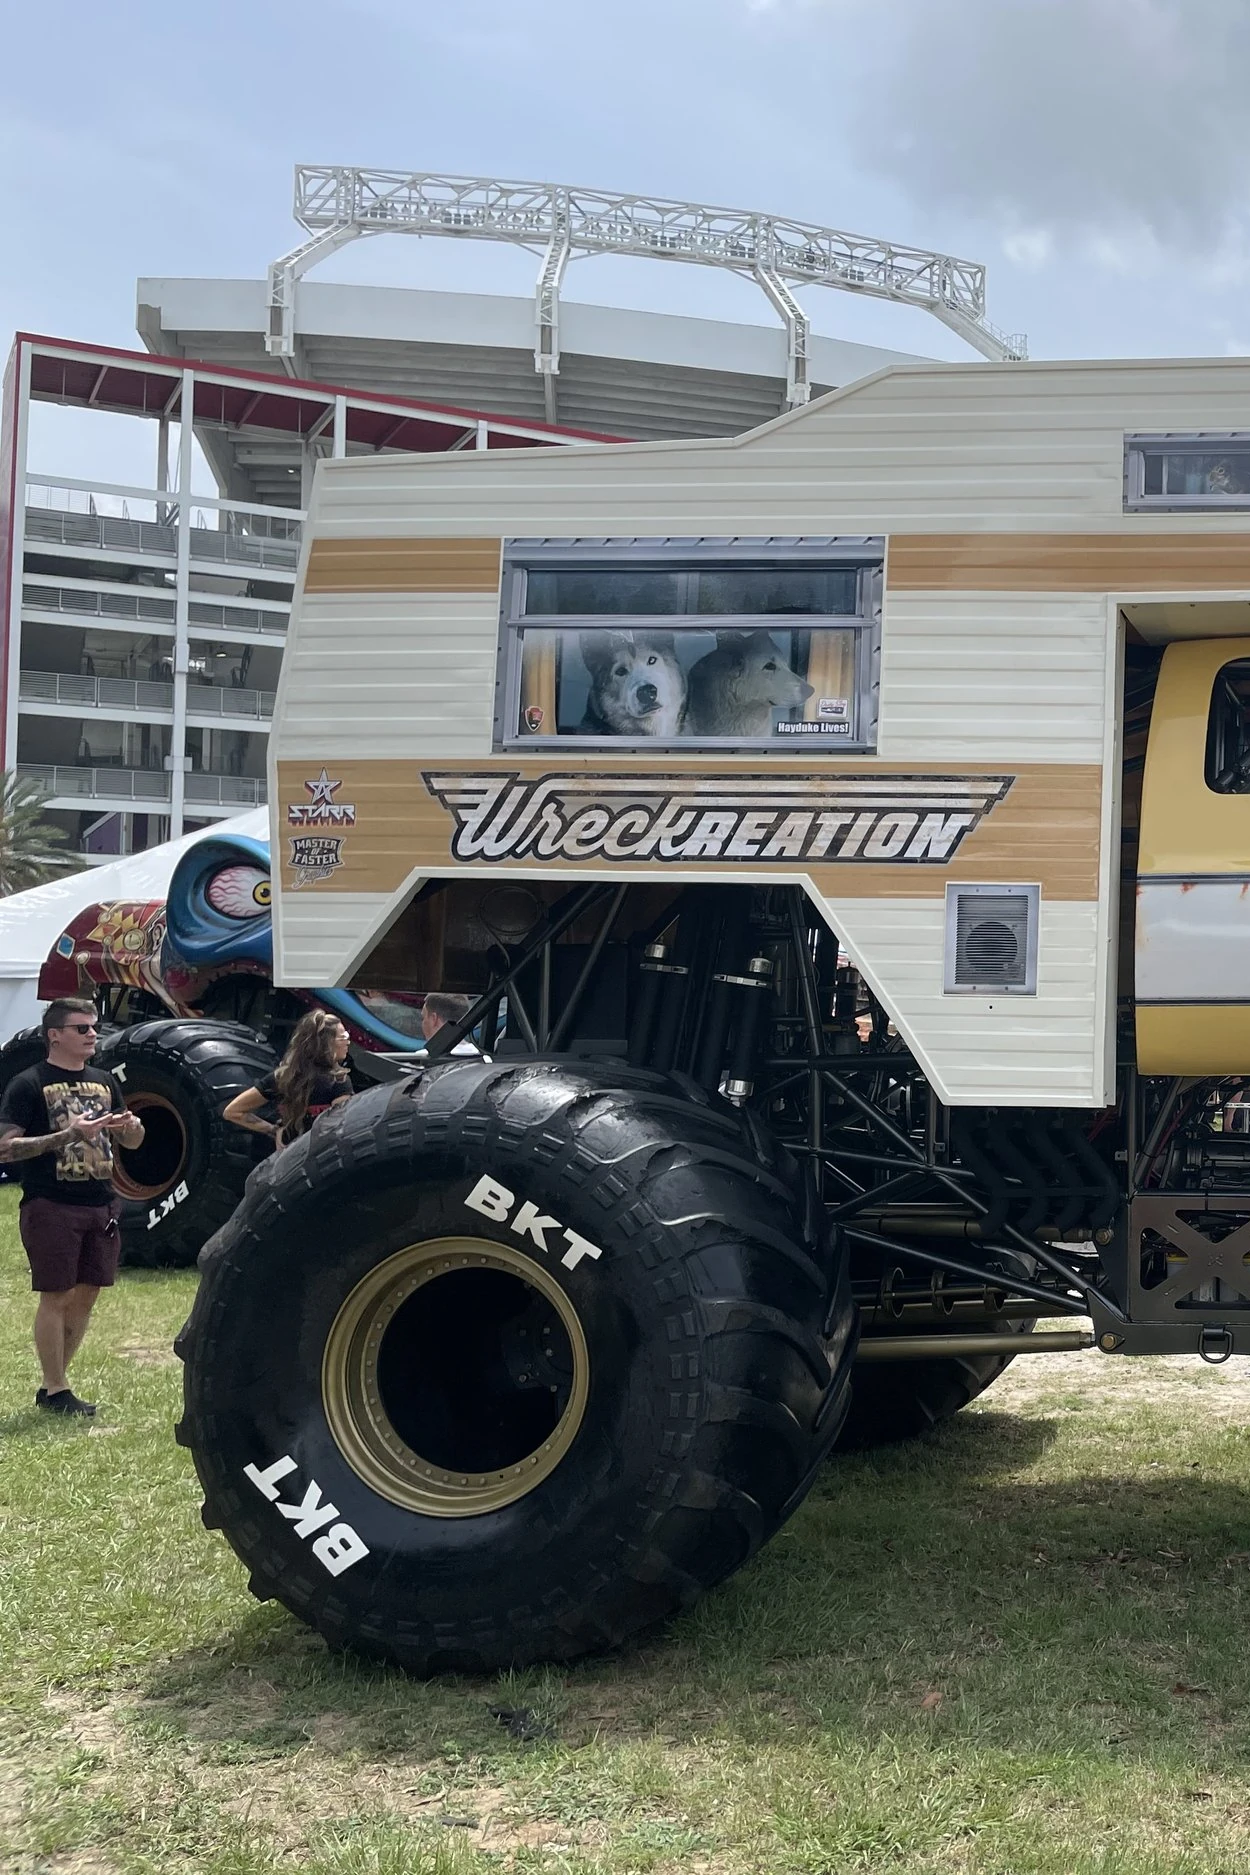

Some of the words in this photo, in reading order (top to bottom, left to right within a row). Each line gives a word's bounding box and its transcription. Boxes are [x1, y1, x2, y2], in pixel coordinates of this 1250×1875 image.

[778, 722, 819, 734] Hayduke
[820, 722, 849, 733] Lives!
[289, 803, 355, 821] STARR
[296, 838, 338, 850] MASTER
[294, 853, 338, 865] FASTER
[146, 1179, 190, 1231] BKT
[463, 1173, 603, 1271] BKT
[242, 1454, 370, 1578] BKT
